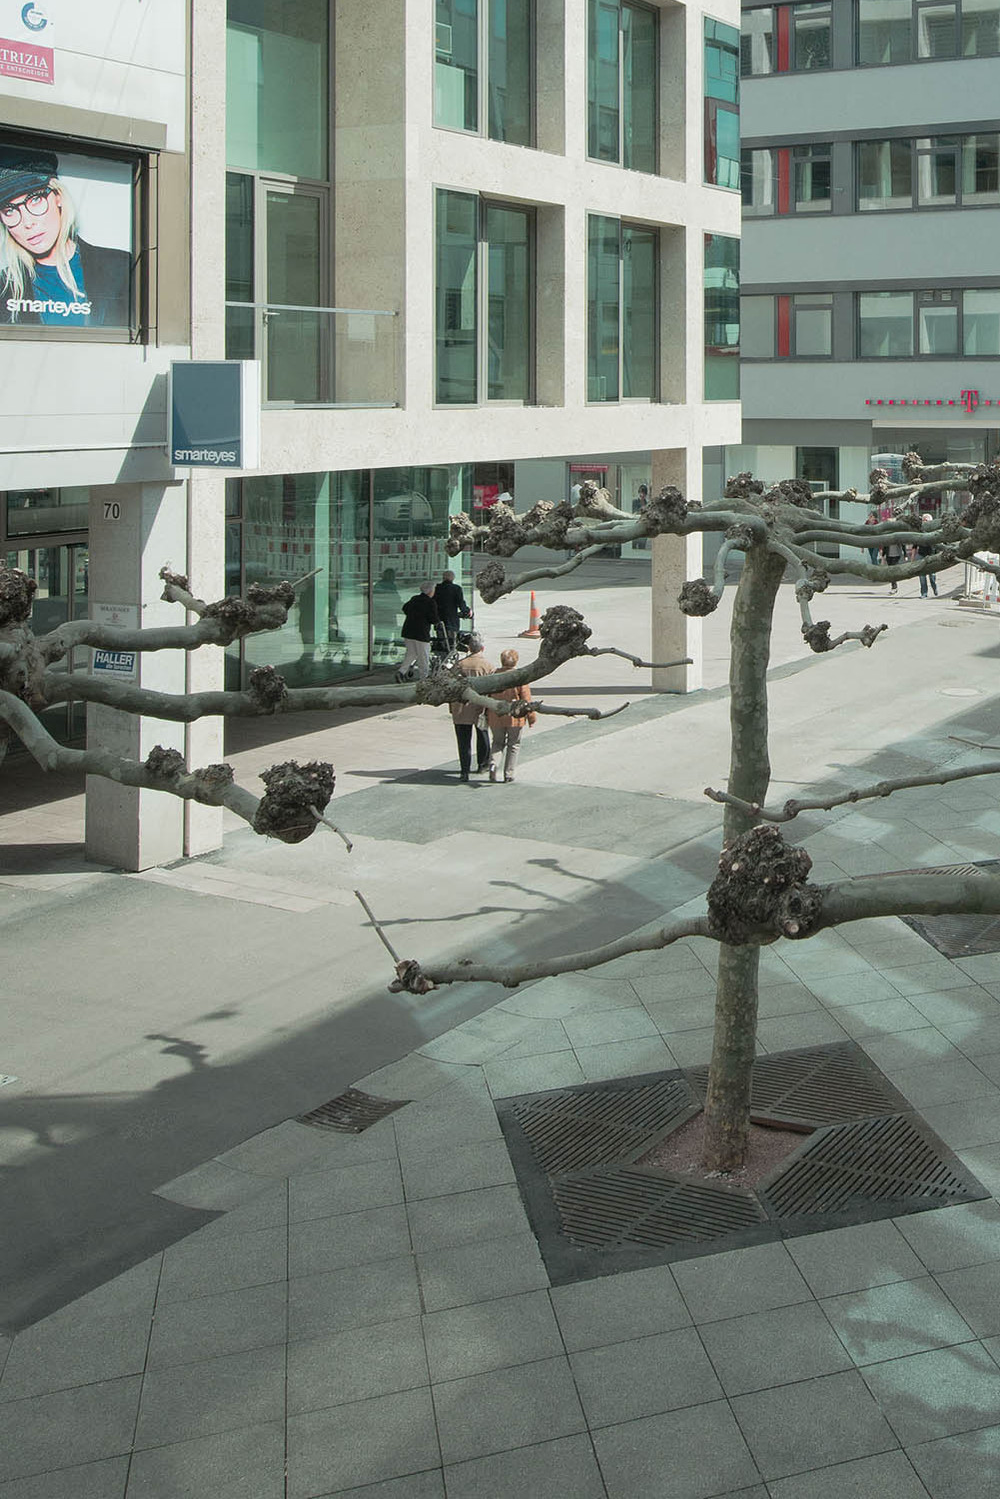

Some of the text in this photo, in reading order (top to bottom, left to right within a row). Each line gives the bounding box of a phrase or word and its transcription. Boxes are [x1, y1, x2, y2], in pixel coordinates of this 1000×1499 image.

[0, 49, 49, 69] TRIZIA
[6, 298, 92, 317] smarteyes
[174, 449, 236, 464] smarteyes
[103, 502, 120, 520] 70
[96, 651, 133, 666] HALLER
